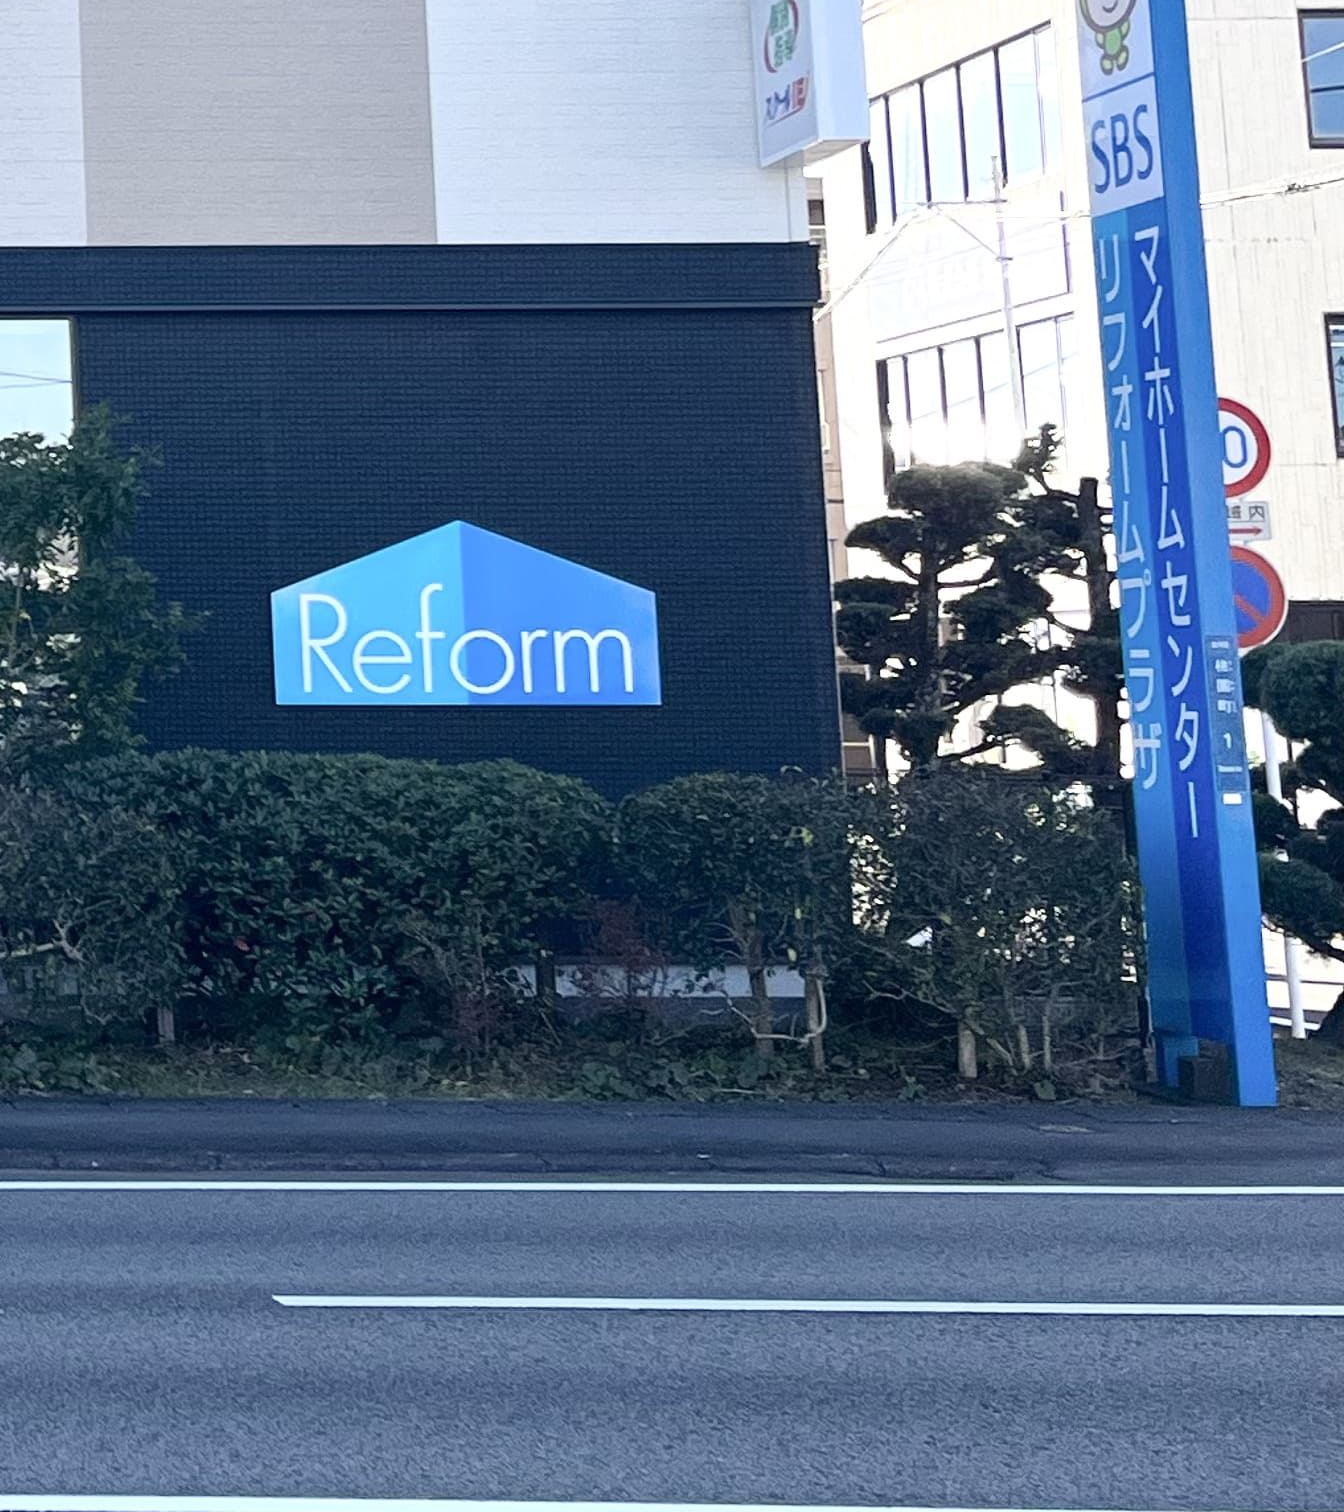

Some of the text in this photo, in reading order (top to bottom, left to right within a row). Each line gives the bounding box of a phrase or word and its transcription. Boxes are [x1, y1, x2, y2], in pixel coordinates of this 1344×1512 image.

[1091, 103, 1154, 194] SBS
[298, 583, 635, 694] Reform
[1098, 232, 1163, 790] リフォームプラザ
[1134, 224, 1200, 838] マイホームセンター
